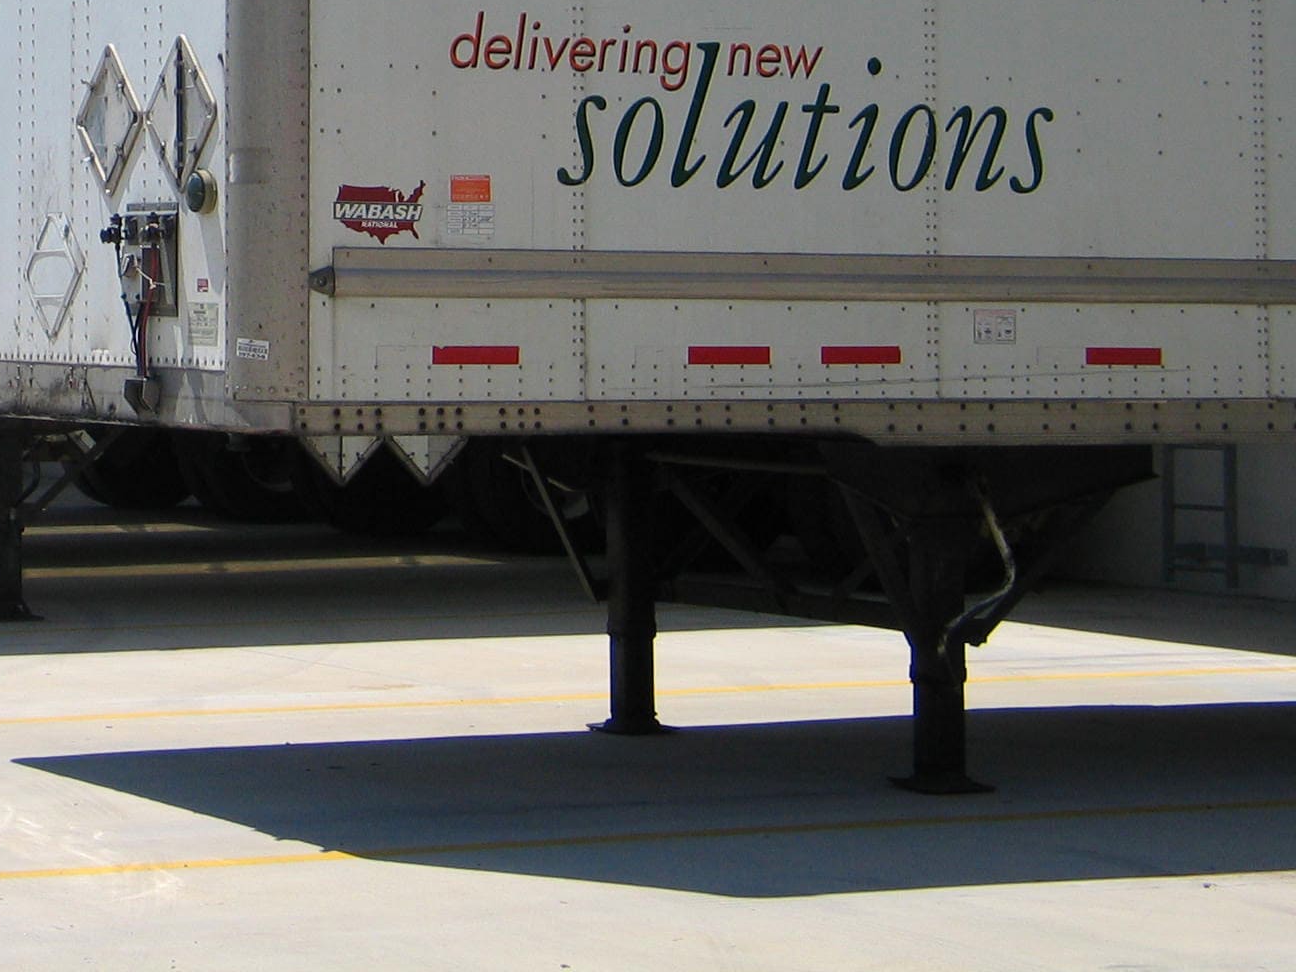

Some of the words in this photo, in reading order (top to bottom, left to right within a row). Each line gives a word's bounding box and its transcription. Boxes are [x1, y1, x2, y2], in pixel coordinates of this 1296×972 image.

[449, 11, 691, 91] delivering
[726, 41, 823, 79] new
[557, 41, 1056, 195] solutions
[335, 203, 423, 220] WABASH
